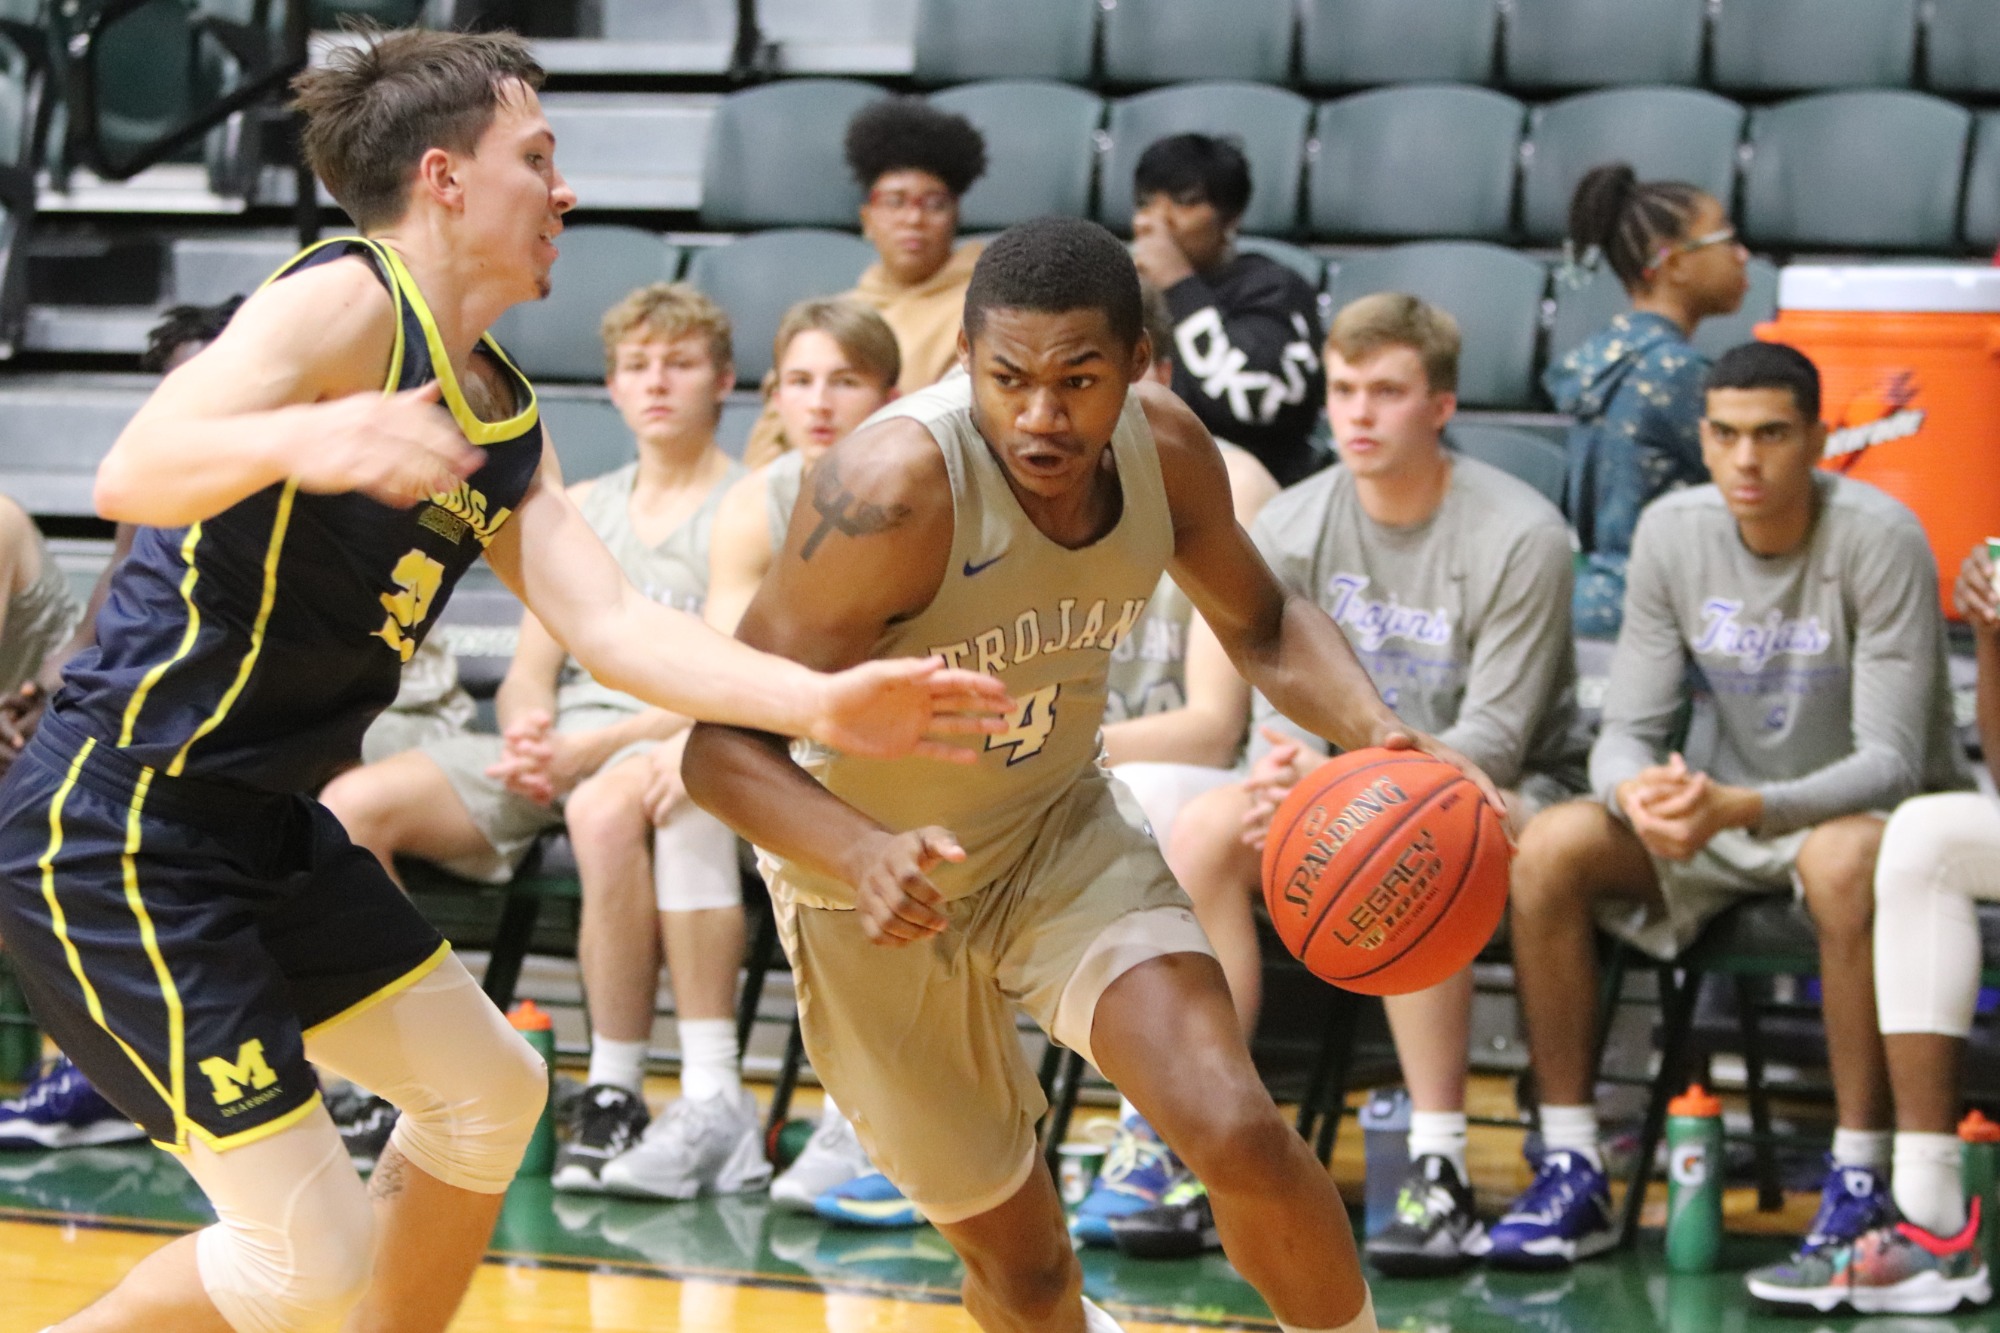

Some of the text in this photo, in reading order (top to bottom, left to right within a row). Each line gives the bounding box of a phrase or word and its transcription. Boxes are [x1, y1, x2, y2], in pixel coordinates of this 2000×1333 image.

[928, 597, 1146, 676] TROJAN
[1327, 572, 1452, 652] Trojans
[1690, 596, 1832, 675] Trojans
[983, 682, 1062, 768] 4
[1284, 775, 1409, 918] SPALDING
[1332, 827, 1437, 947] LEGACY
[197, 1038, 279, 1106] M
[1671, 1144, 1707, 1187] G
